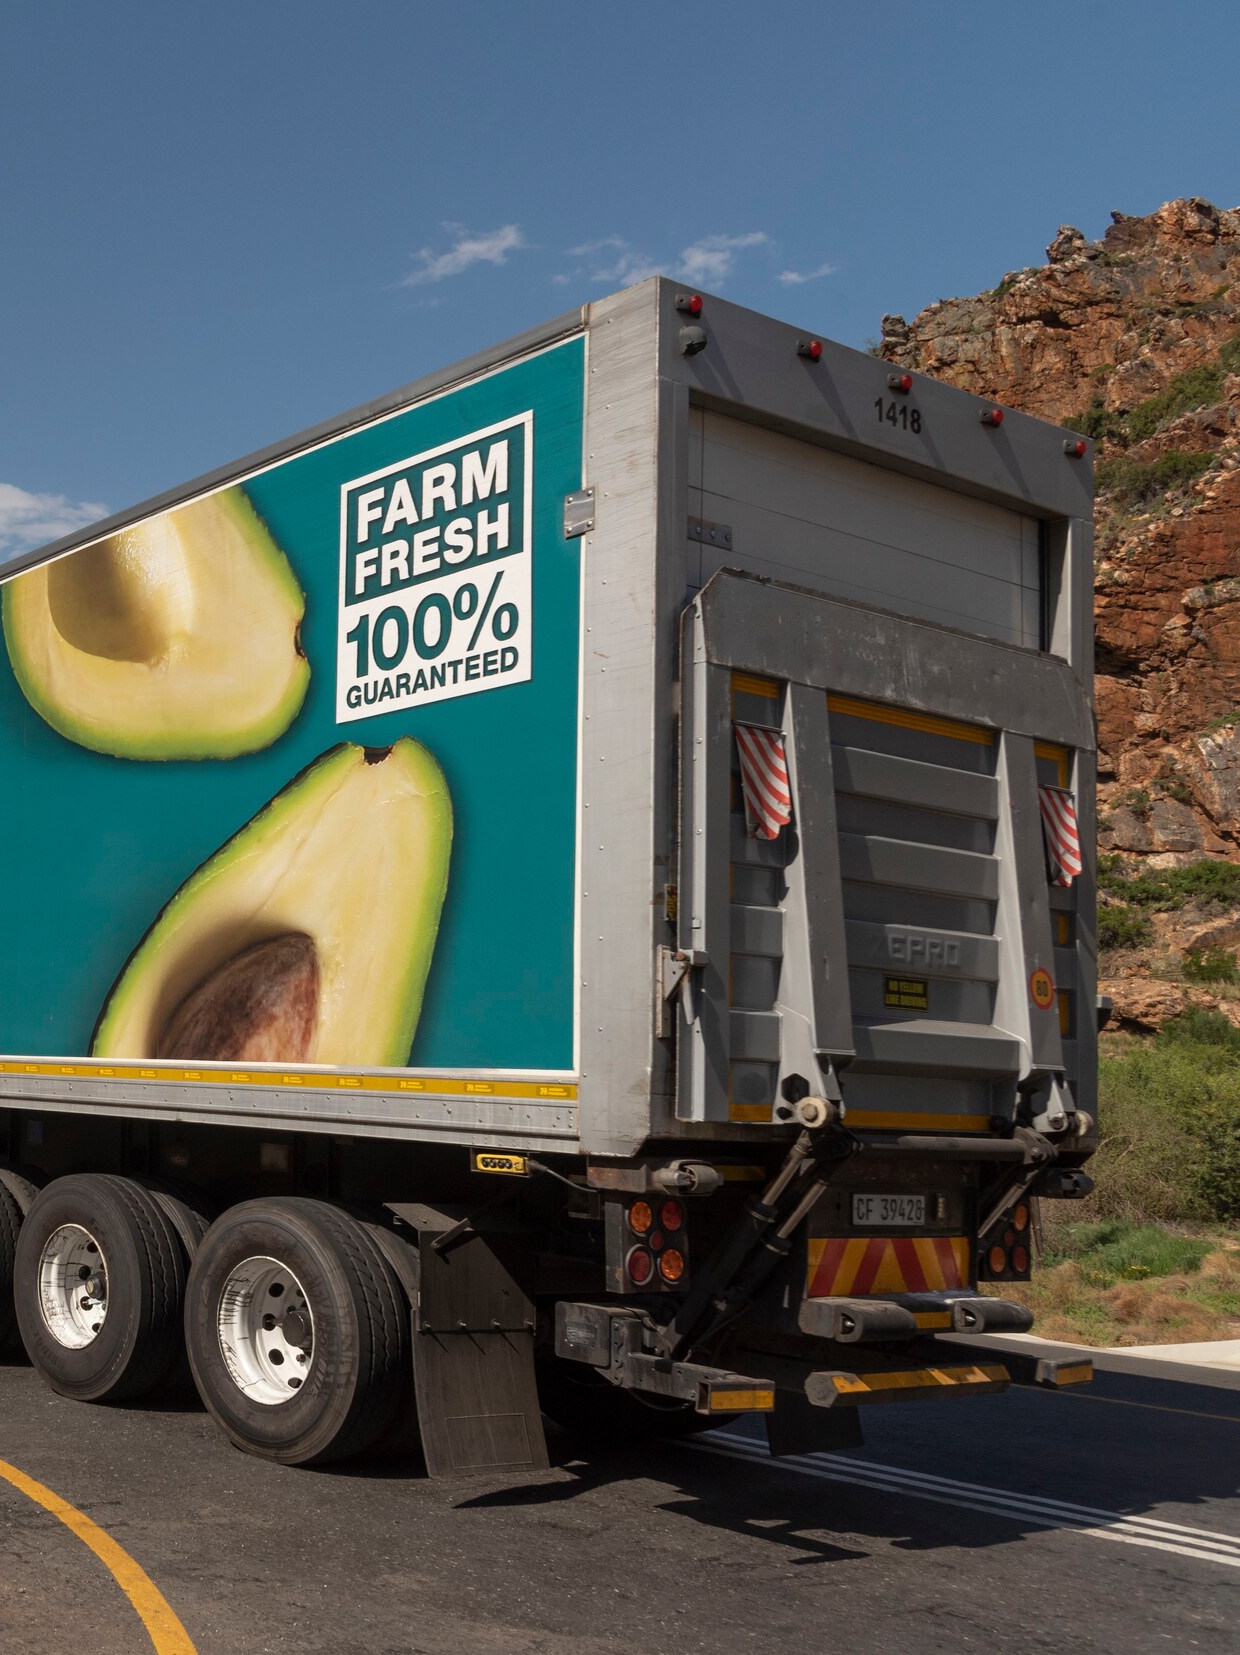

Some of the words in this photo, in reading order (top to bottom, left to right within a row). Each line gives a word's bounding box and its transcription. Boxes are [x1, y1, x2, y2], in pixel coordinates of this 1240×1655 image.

[873, 397, 922, 435] 1418
[357, 438, 510, 544] FARM
[354, 501, 510, 596] FRESH
[346, 570, 519, 679] 100%
[346, 645, 519, 710] GUARANTEED
[870, 933, 961, 967] EPRO
[856, 1198, 874, 1221] CF
